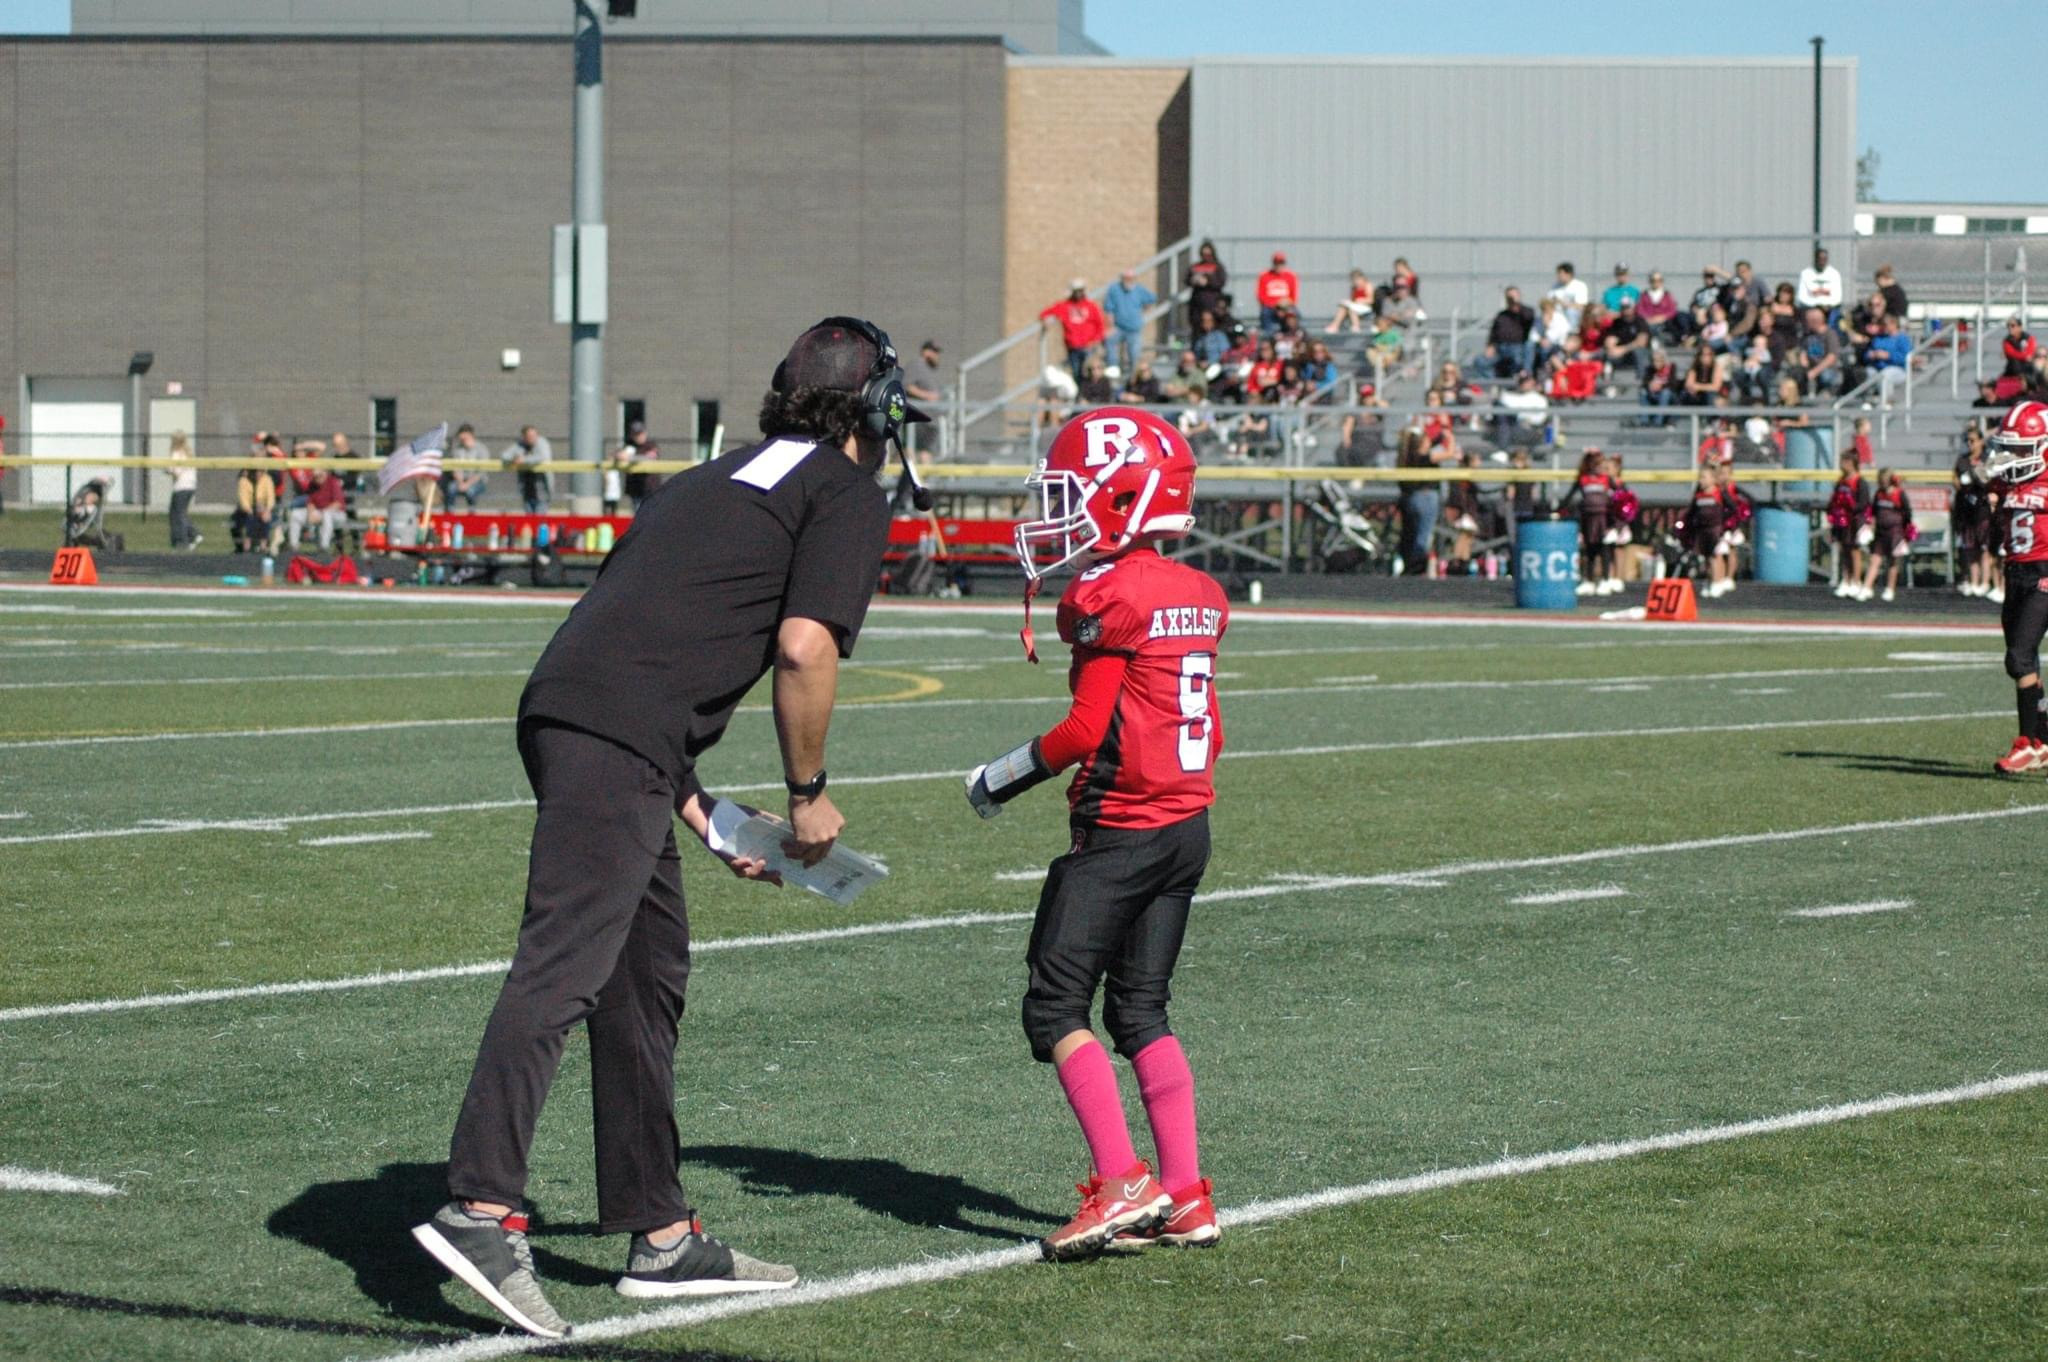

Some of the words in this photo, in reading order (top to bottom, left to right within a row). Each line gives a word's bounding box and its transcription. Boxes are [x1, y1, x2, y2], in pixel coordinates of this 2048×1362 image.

[1083, 417, 1145, 467] R
[53, 553, 83, 578] 30
[1647, 583, 1684, 614] 50
